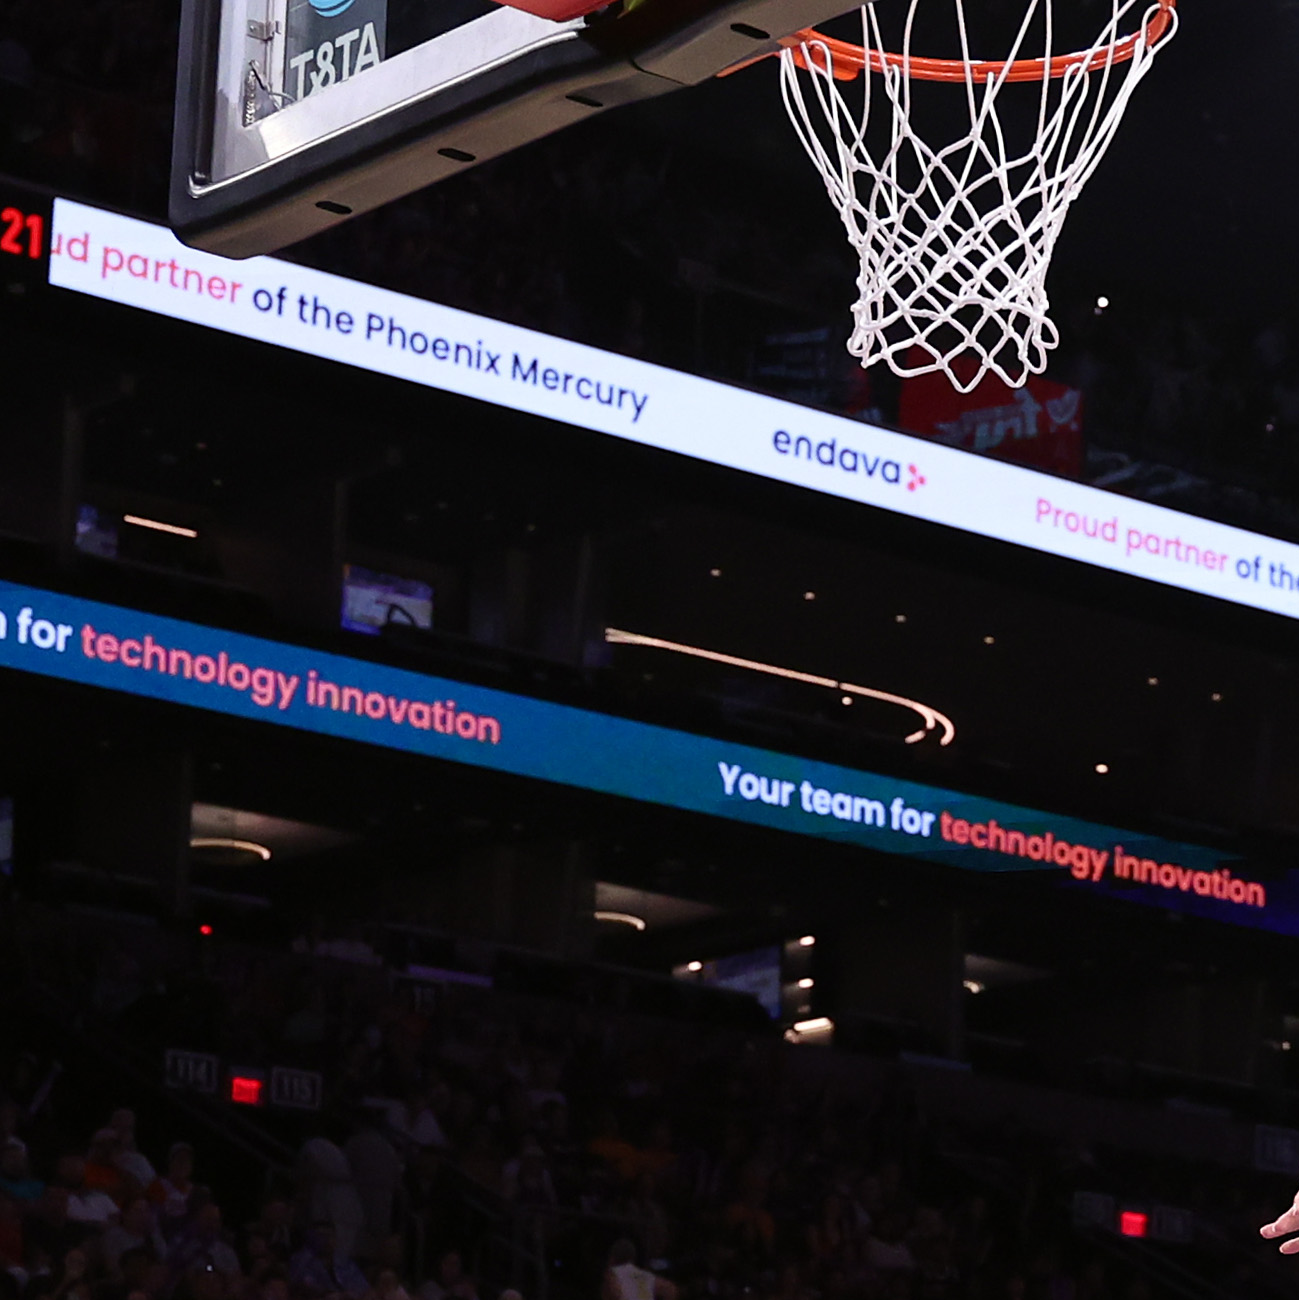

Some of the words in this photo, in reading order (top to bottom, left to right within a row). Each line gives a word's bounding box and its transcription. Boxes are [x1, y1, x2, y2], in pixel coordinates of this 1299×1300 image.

[0, 207, 43, 259] 21
[102, 245, 243, 304] partner
[253, 286, 287, 313] of
[299, 294, 354, 334] the
[366, 313, 501, 375] Phoenix
[511, 352, 648, 423] Mercury
[773, 429, 901, 485] endava
[1036, 497, 1117, 544] Proud
[1125, 526, 1228, 575] partner
[1236, 553, 1268, 584] of
[17, 607, 75, 654] for
[81, 623, 299, 710] technology
[306, 669, 502, 745] innovation
[718, 760, 795, 809] Your
[801, 777, 885, 828] team
[891, 799, 938, 839] for
[941, 811, 1107, 881] technology
[1114, 845, 1265, 908] innovation
